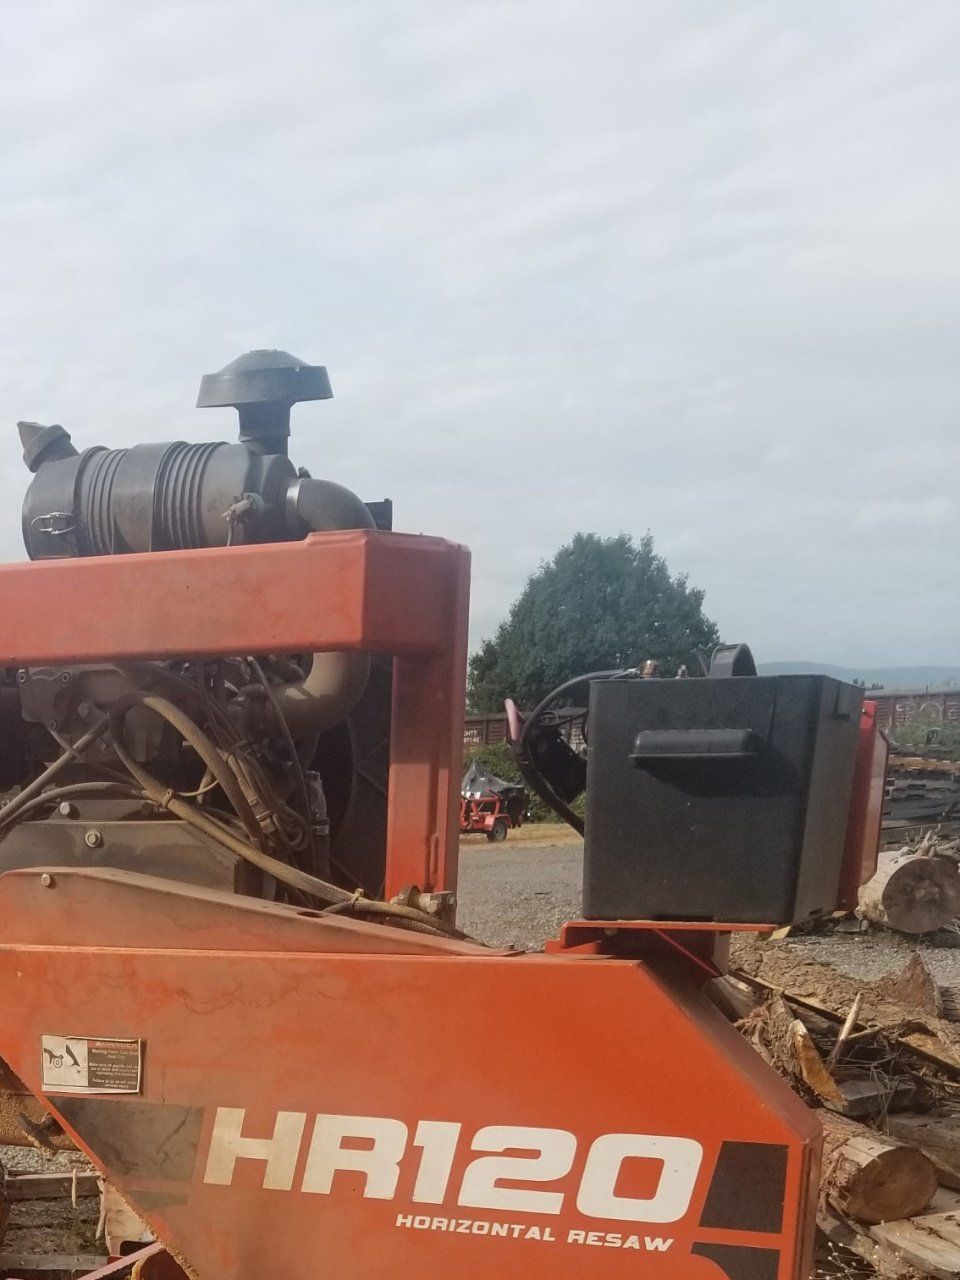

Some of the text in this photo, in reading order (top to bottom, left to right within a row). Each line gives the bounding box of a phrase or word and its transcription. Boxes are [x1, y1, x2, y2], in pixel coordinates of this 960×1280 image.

[203, 1106, 704, 1224] HR120
[395, 1213, 674, 1252] HORIZONTAL RESAW
